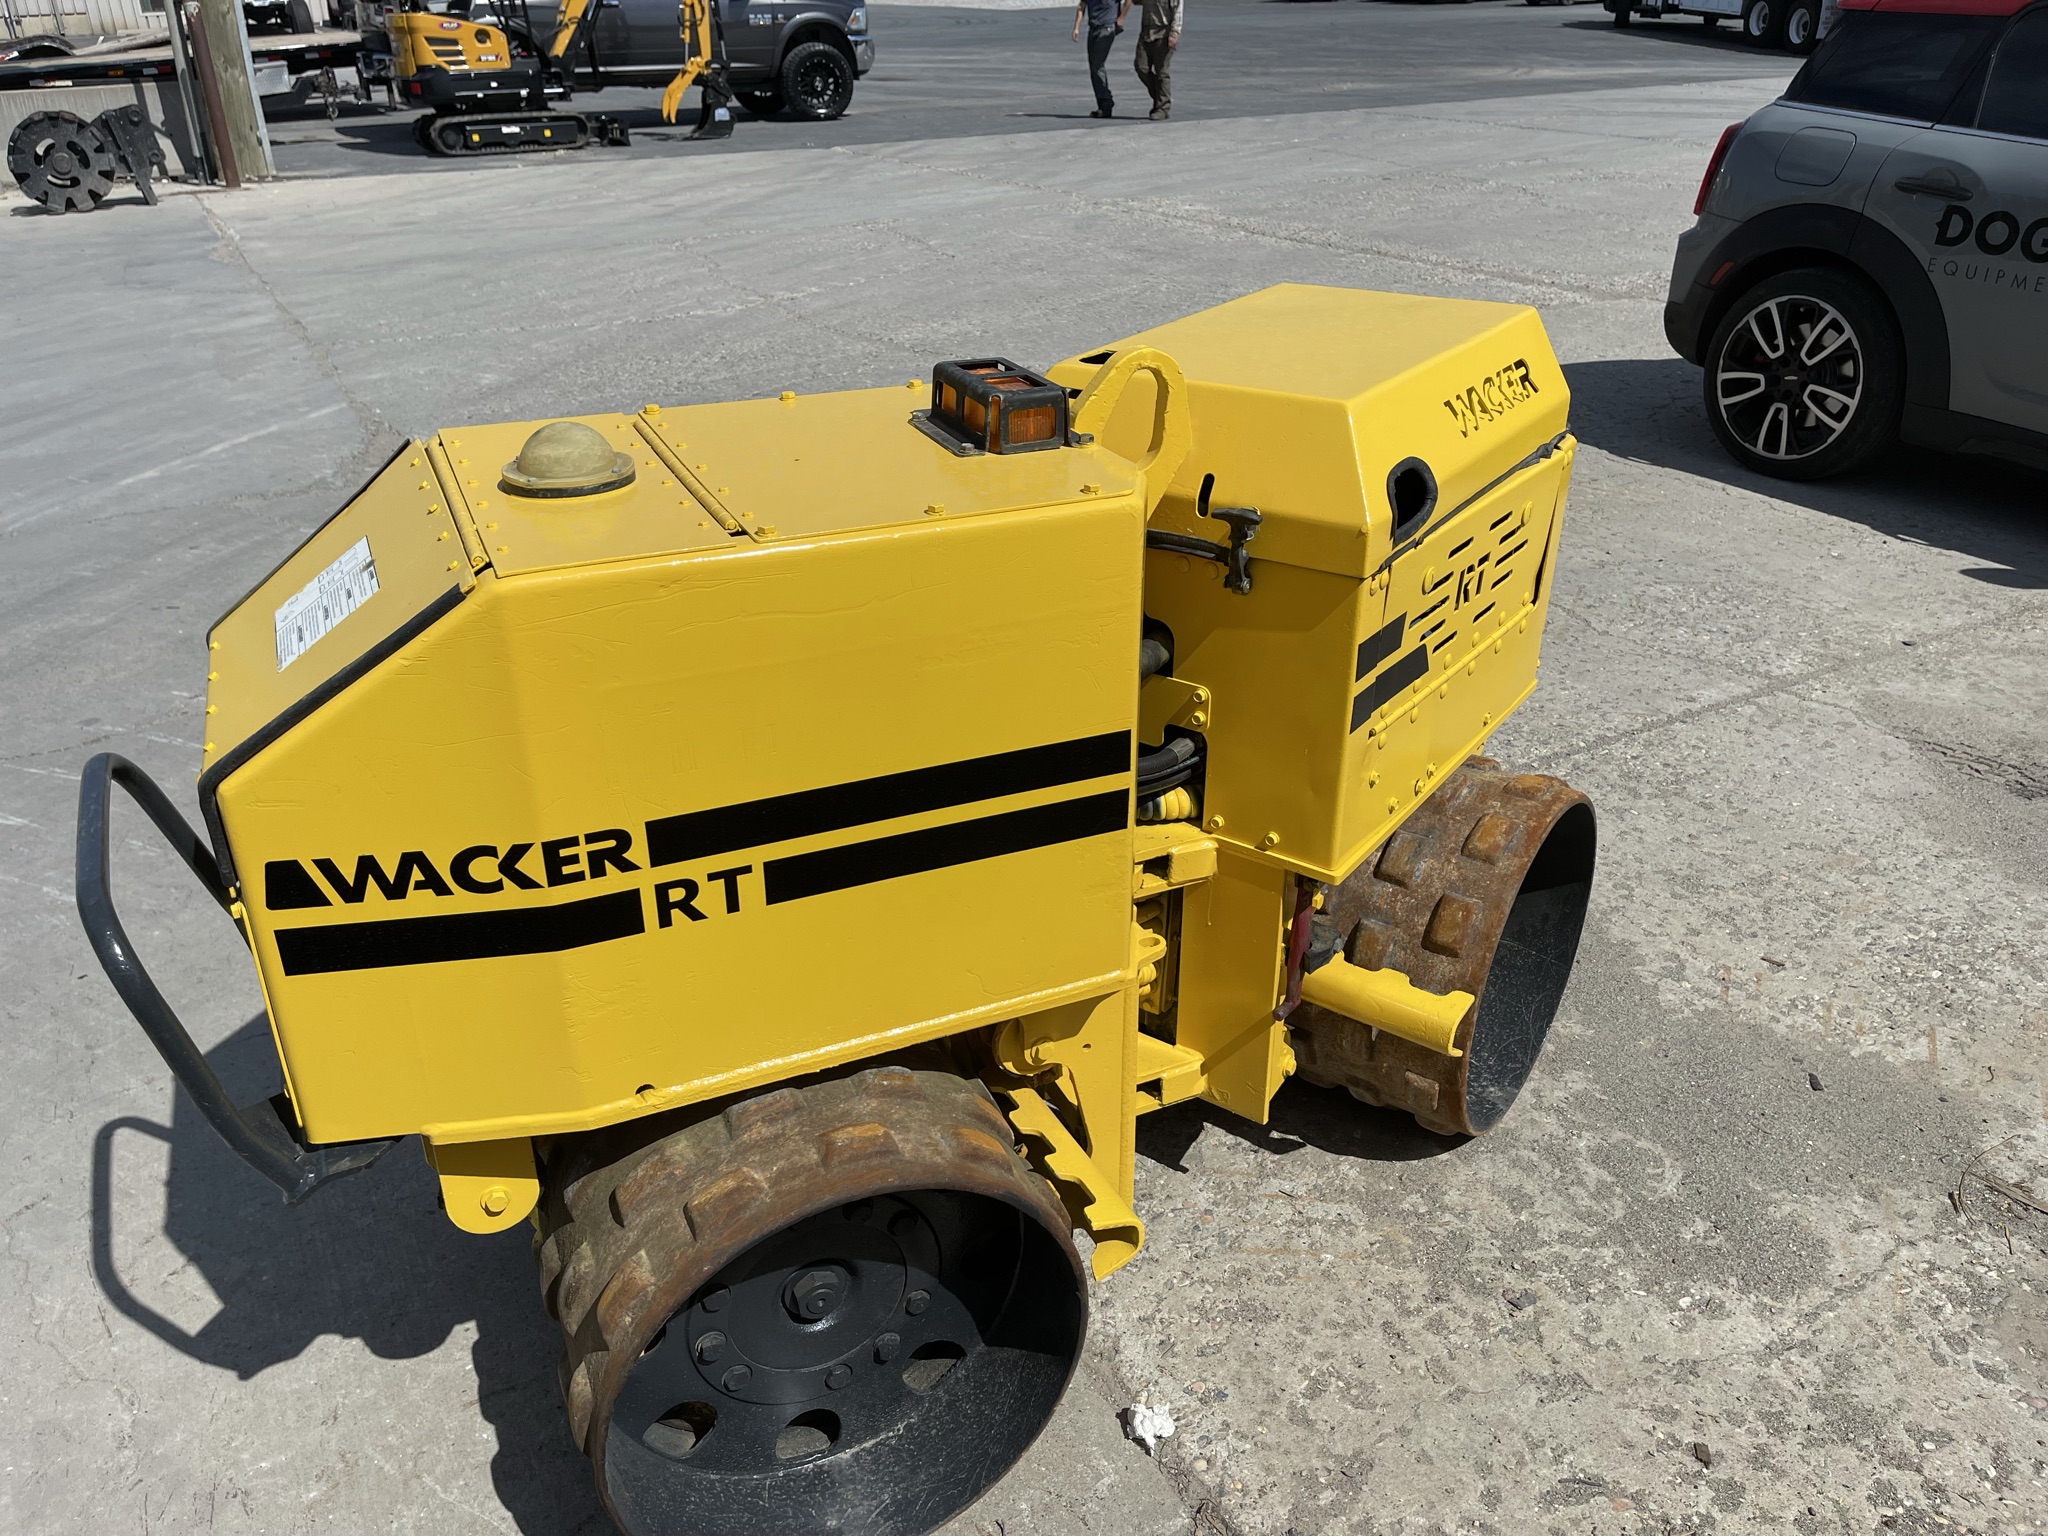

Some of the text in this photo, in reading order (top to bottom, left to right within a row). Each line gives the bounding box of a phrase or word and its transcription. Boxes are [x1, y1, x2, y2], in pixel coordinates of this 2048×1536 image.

[1934, 204, 2048, 263] DOG
[1927, 257, 2045, 292] EQUIPME
[1443, 358, 1539, 438] WACKER
[1454, 551, 1491, 615] RT
[311, 828, 642, 904] WACKER
[654, 864, 753, 929] RT
